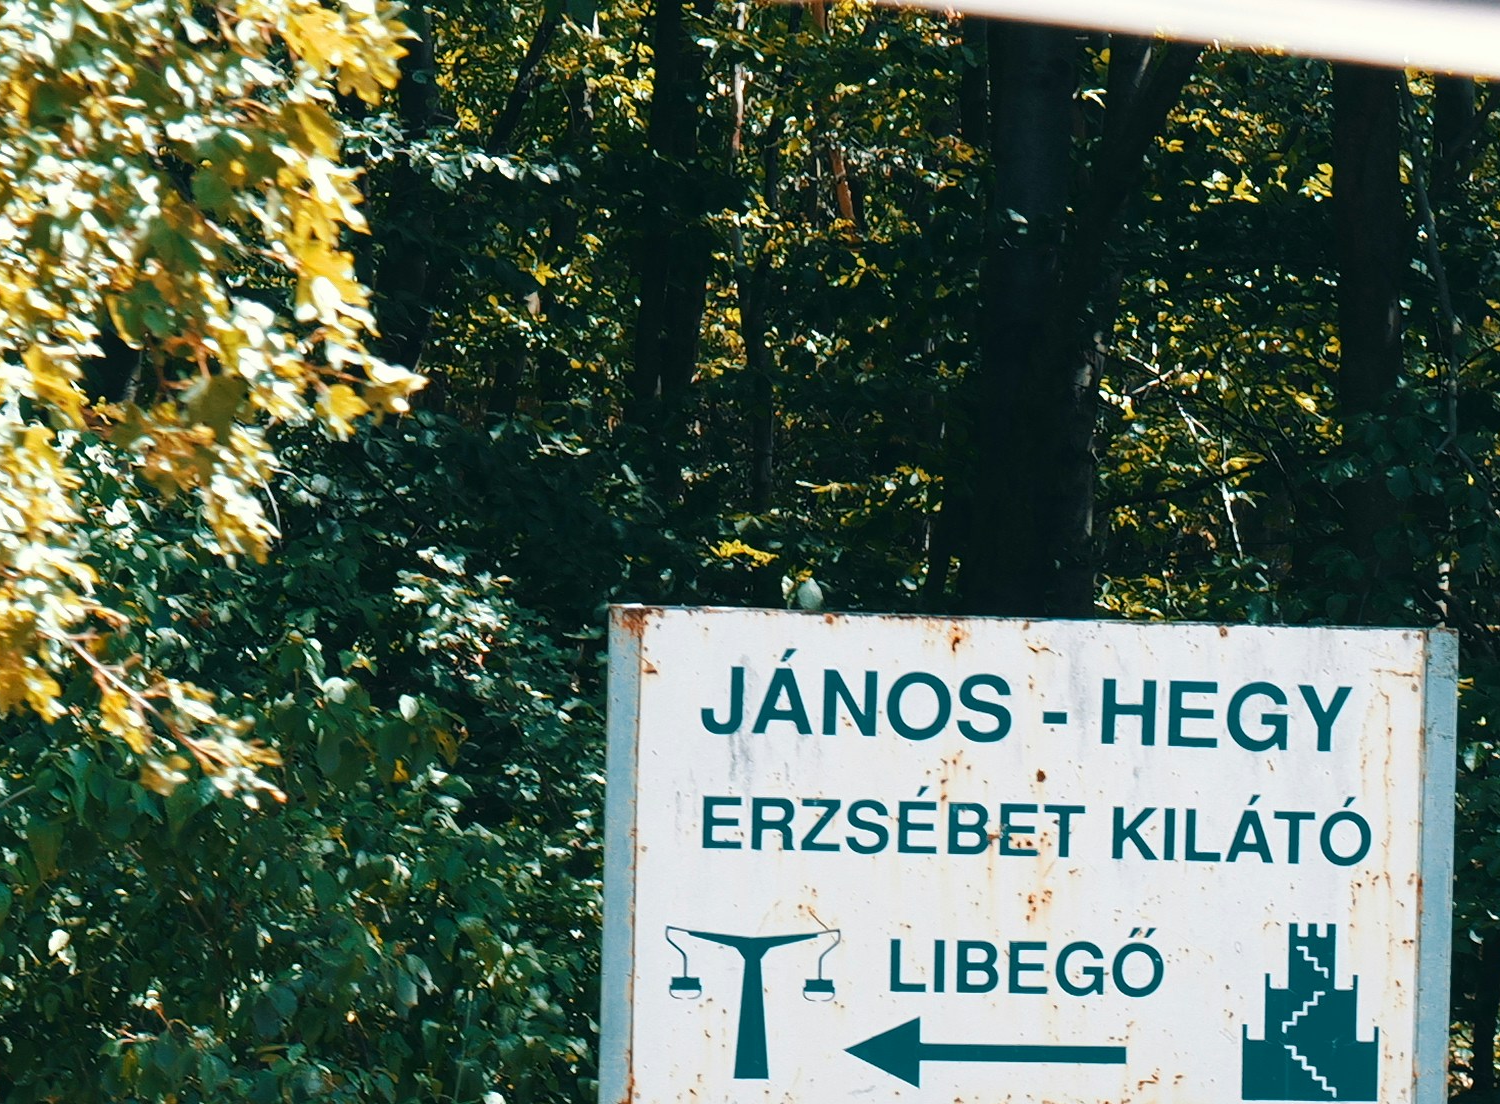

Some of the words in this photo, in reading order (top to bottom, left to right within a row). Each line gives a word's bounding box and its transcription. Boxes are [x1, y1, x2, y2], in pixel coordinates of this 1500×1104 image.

[700, 648, 1012, 743] JÁNOS
[1042, 711, 1068, 725] -
[1101, 678, 1353, 753] HEGY
[702, 785, 1086, 858] ERZSÉBET
[1111, 794, 1372, 867] KILÁTÓ
[889, 927, 1165, 998] LIBEGŐ
